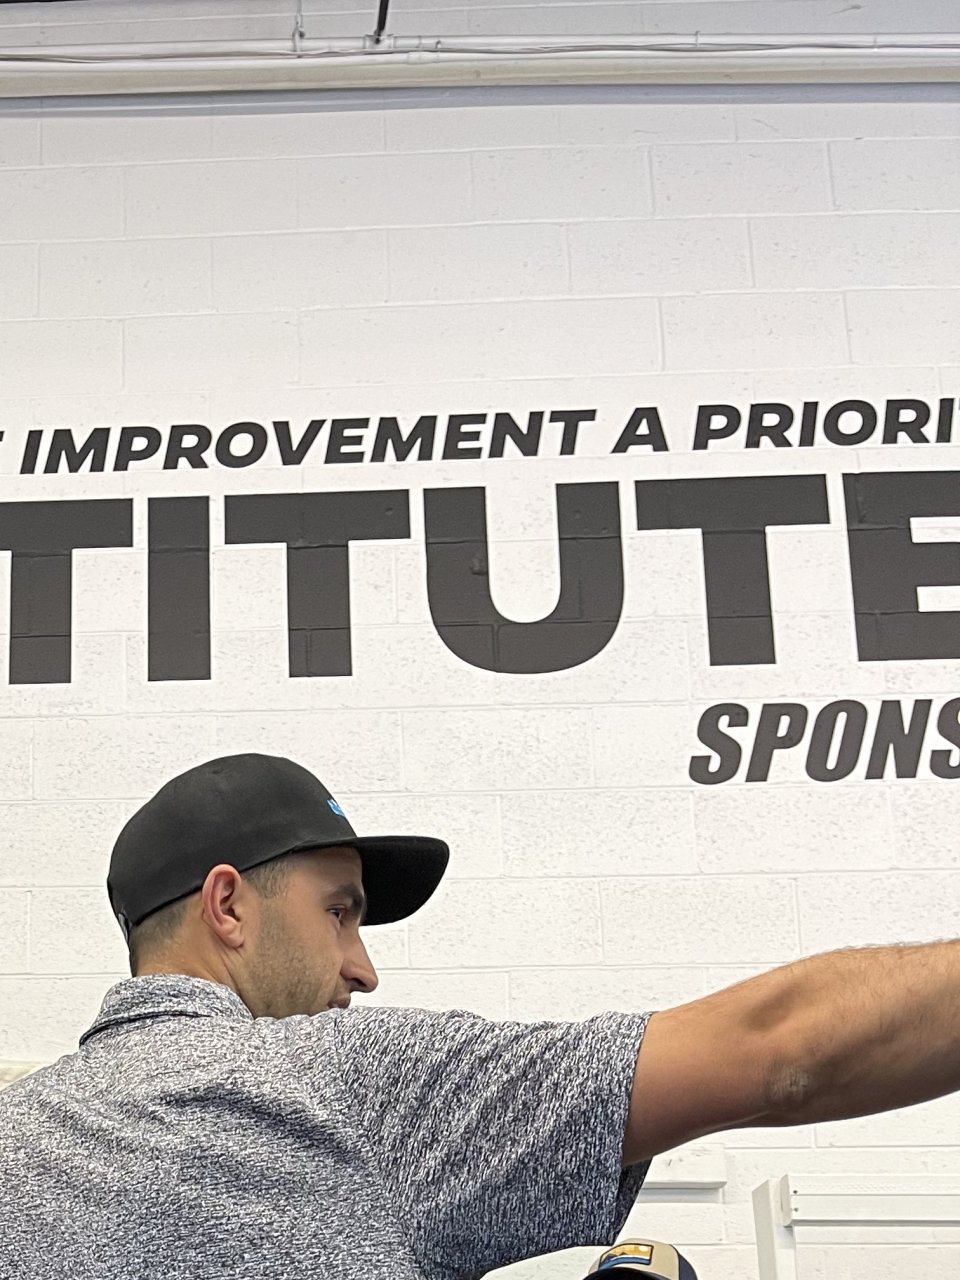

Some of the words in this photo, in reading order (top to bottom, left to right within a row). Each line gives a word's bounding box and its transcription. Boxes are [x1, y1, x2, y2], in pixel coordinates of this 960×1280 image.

[19, 409, 598, 475] IMPROVEMENT
[610, 406, 670, 455] A
[692, 397, 960, 451] PRIORI
